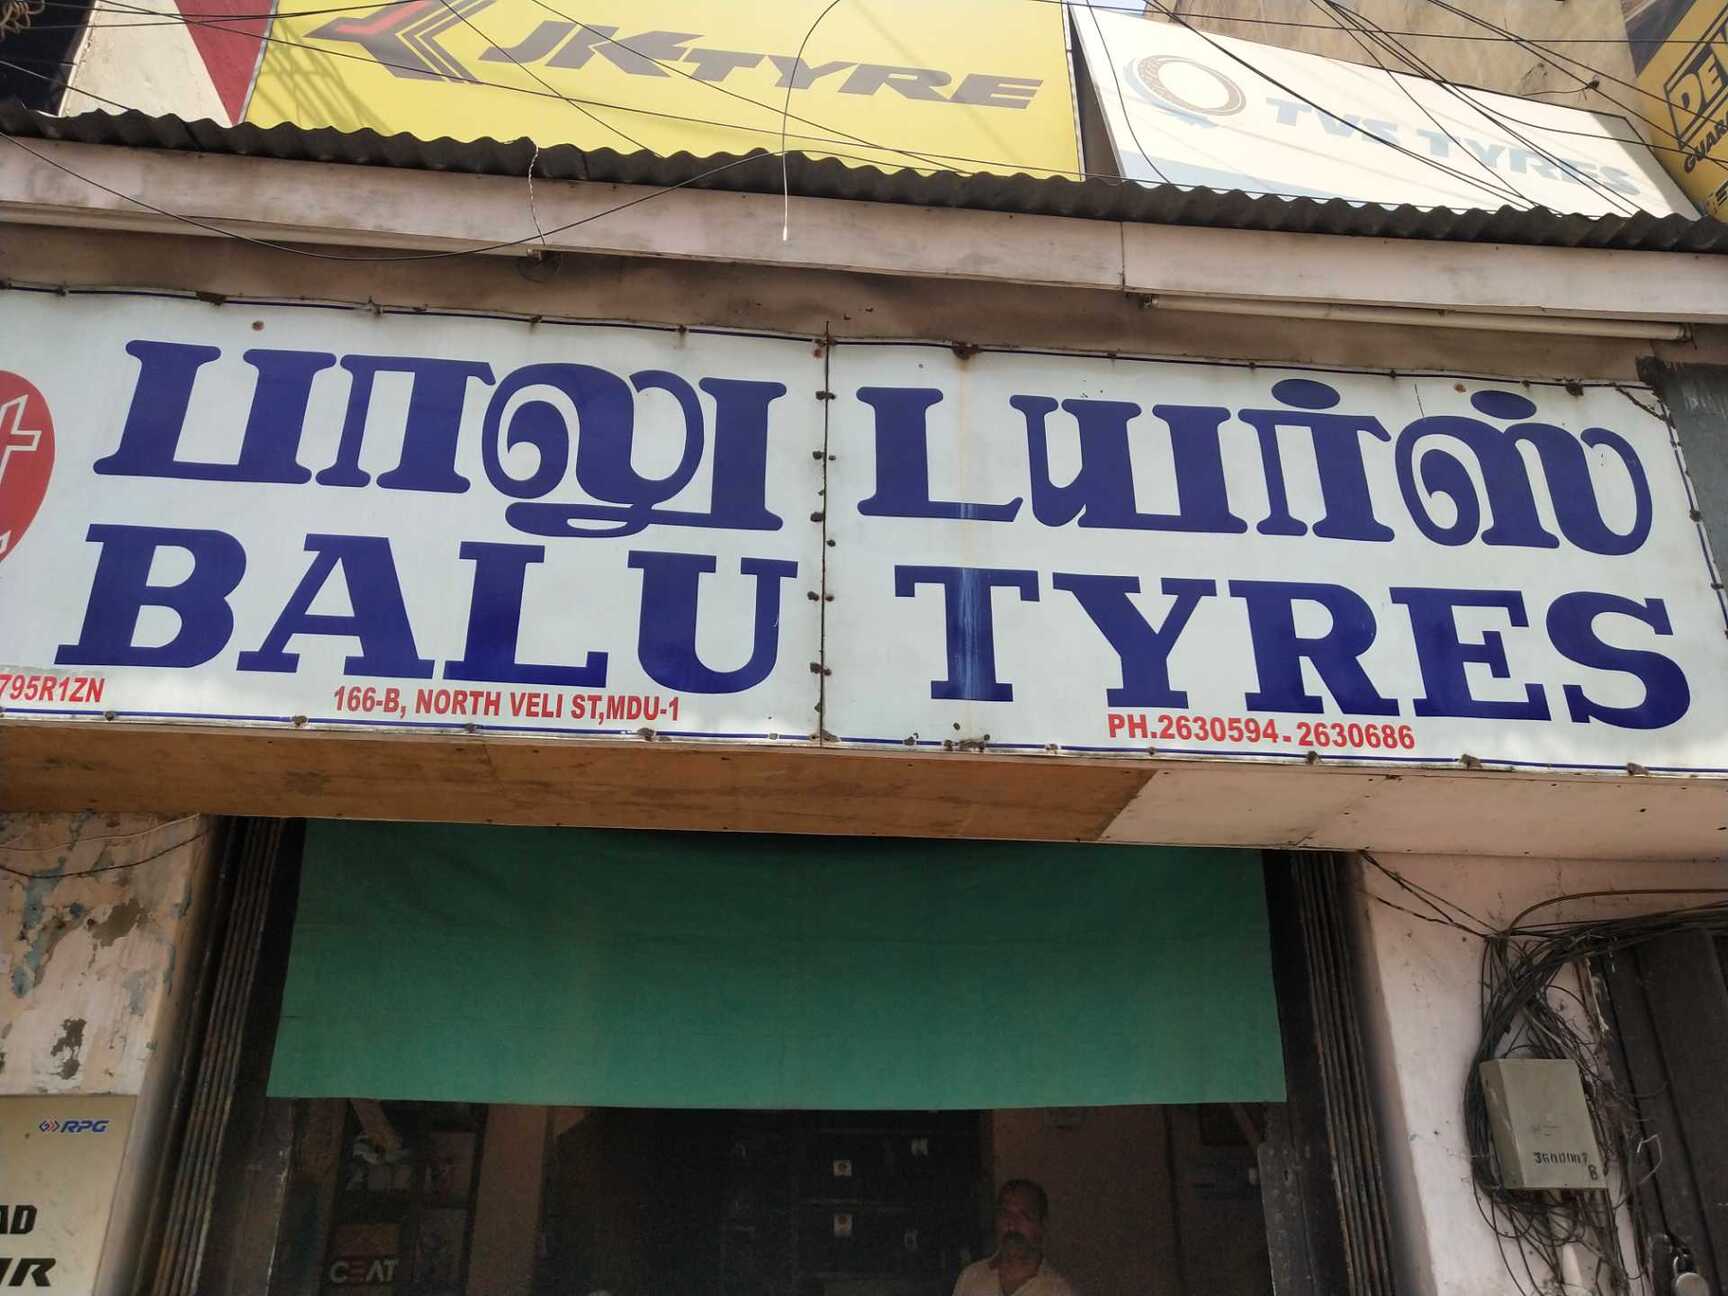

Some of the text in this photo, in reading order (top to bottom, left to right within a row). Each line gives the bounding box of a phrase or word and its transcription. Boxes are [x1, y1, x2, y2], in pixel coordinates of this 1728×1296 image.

[1266, 97, 1641, 196] TVS TYRES
[1684, 110, 1728, 174] GUAR
[93, 340, 788, 538] பாலு
[857, 379, 1653, 556] டயர்ஸ்
[54, 523, 1691, 730] BALU TYRES
[334, 685, 407, 719] 166-B,
[415, 688, 501, 717] NORTH
[510, 692, 563, 719] VELI
[61, 1120, 109, 1133] RPG
[329, 1259, 401, 1285] CEAT
